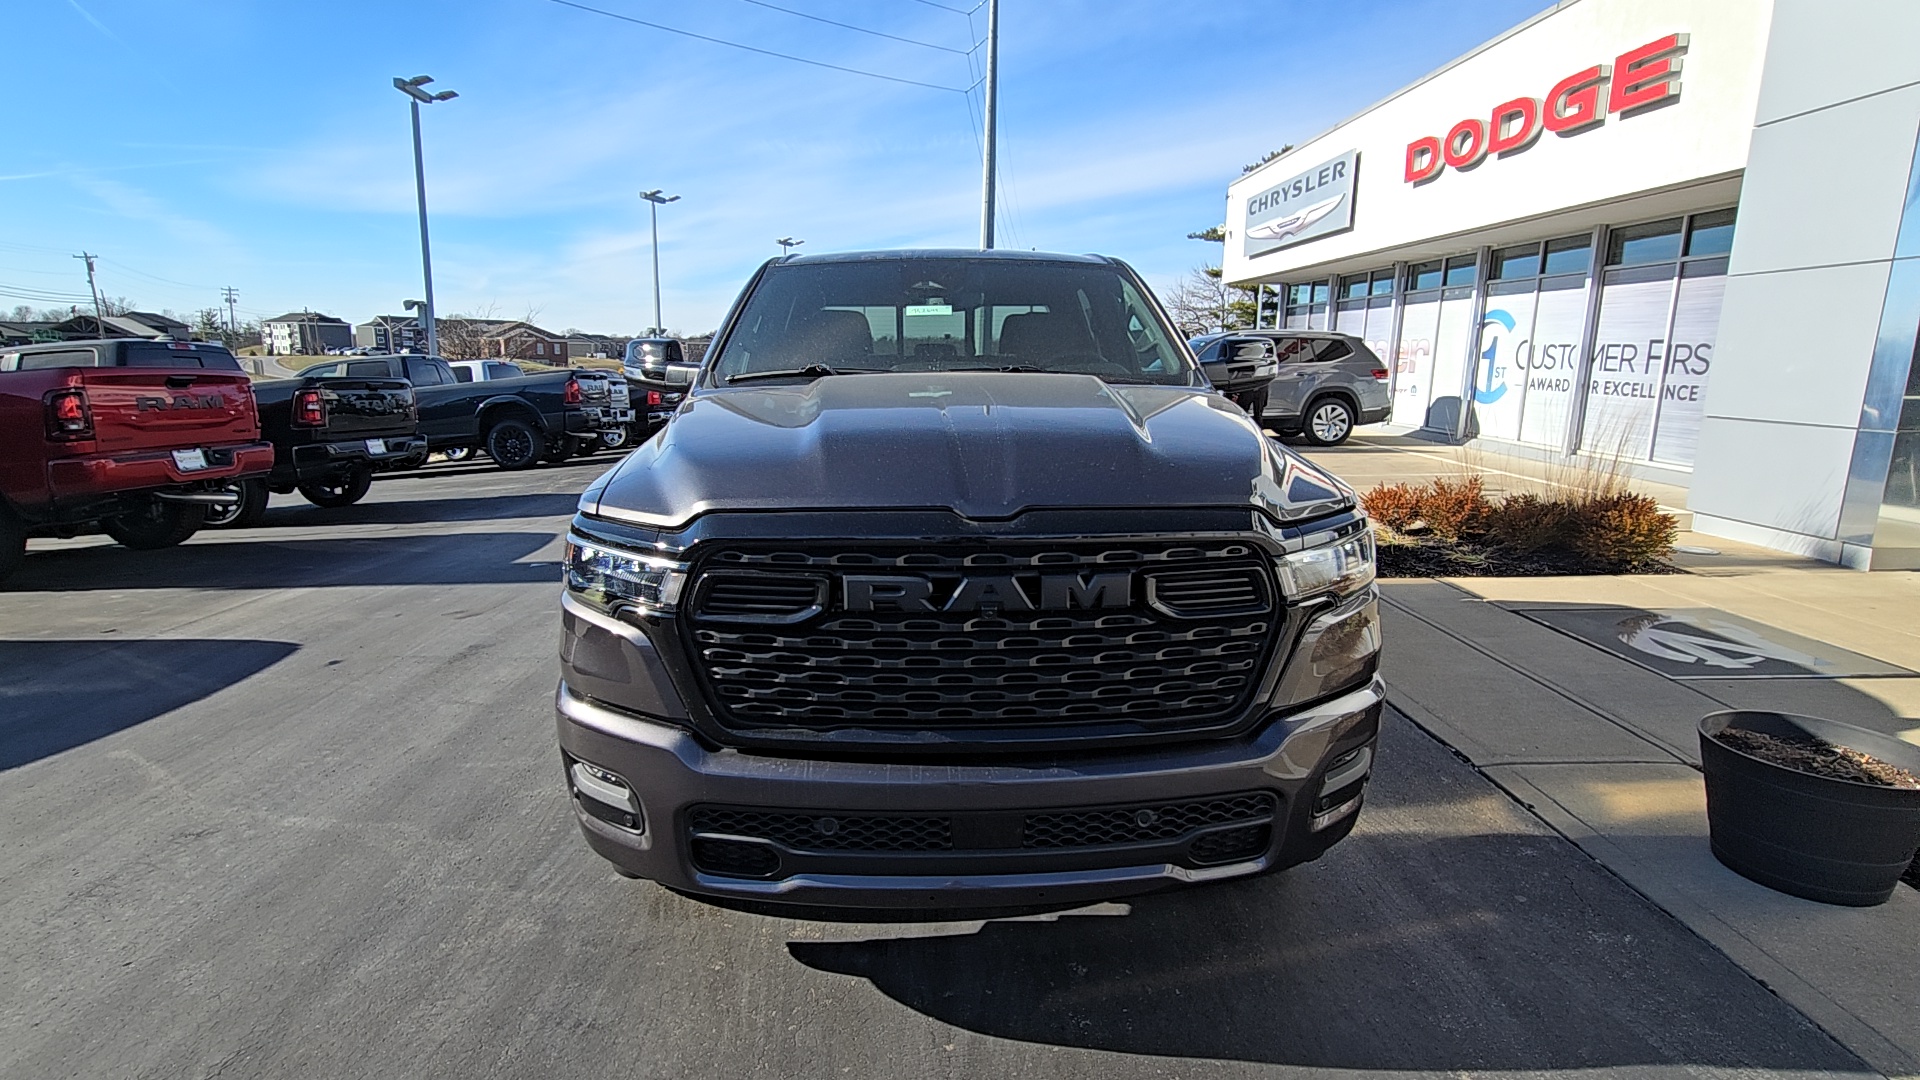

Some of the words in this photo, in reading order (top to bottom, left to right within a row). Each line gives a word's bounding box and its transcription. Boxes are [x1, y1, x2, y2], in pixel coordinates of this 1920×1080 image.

[1404, 33, 1688, 183] DODGE
[1249, 160, 1346, 216] CHRYSLER
[135, 395, 225, 412] RAM
[355, 399, 397, 411] RAM
[1529, 377, 1570, 392] AWARD
[1603, 380, 1699, 402] EXCELLNCE
[842, 573, 1132, 613] RAM
